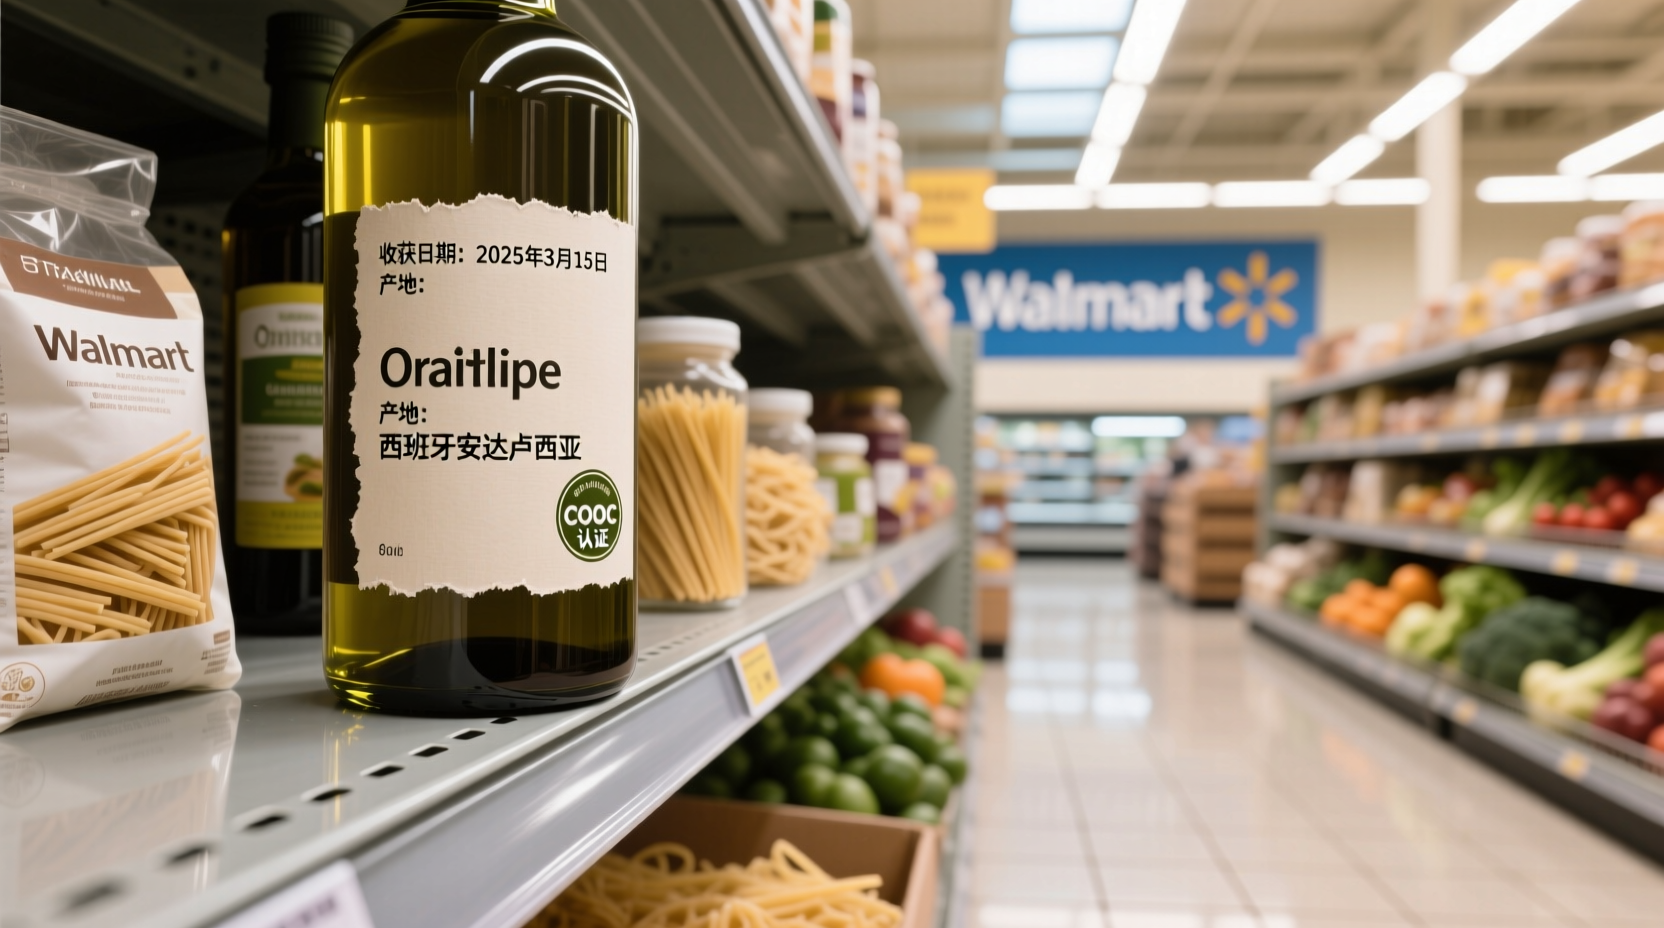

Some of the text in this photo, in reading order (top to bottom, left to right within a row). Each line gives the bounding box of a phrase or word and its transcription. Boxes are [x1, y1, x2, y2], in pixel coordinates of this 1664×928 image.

[962, 268, 1213, 333] Walmart
[33, 325, 195, 372] Walmart
[380, 346, 561, 400] Oraitlipe
[379, 432, 582, 461] 西班牙安达卢西亚
[564, 504, 617, 526] COOC
